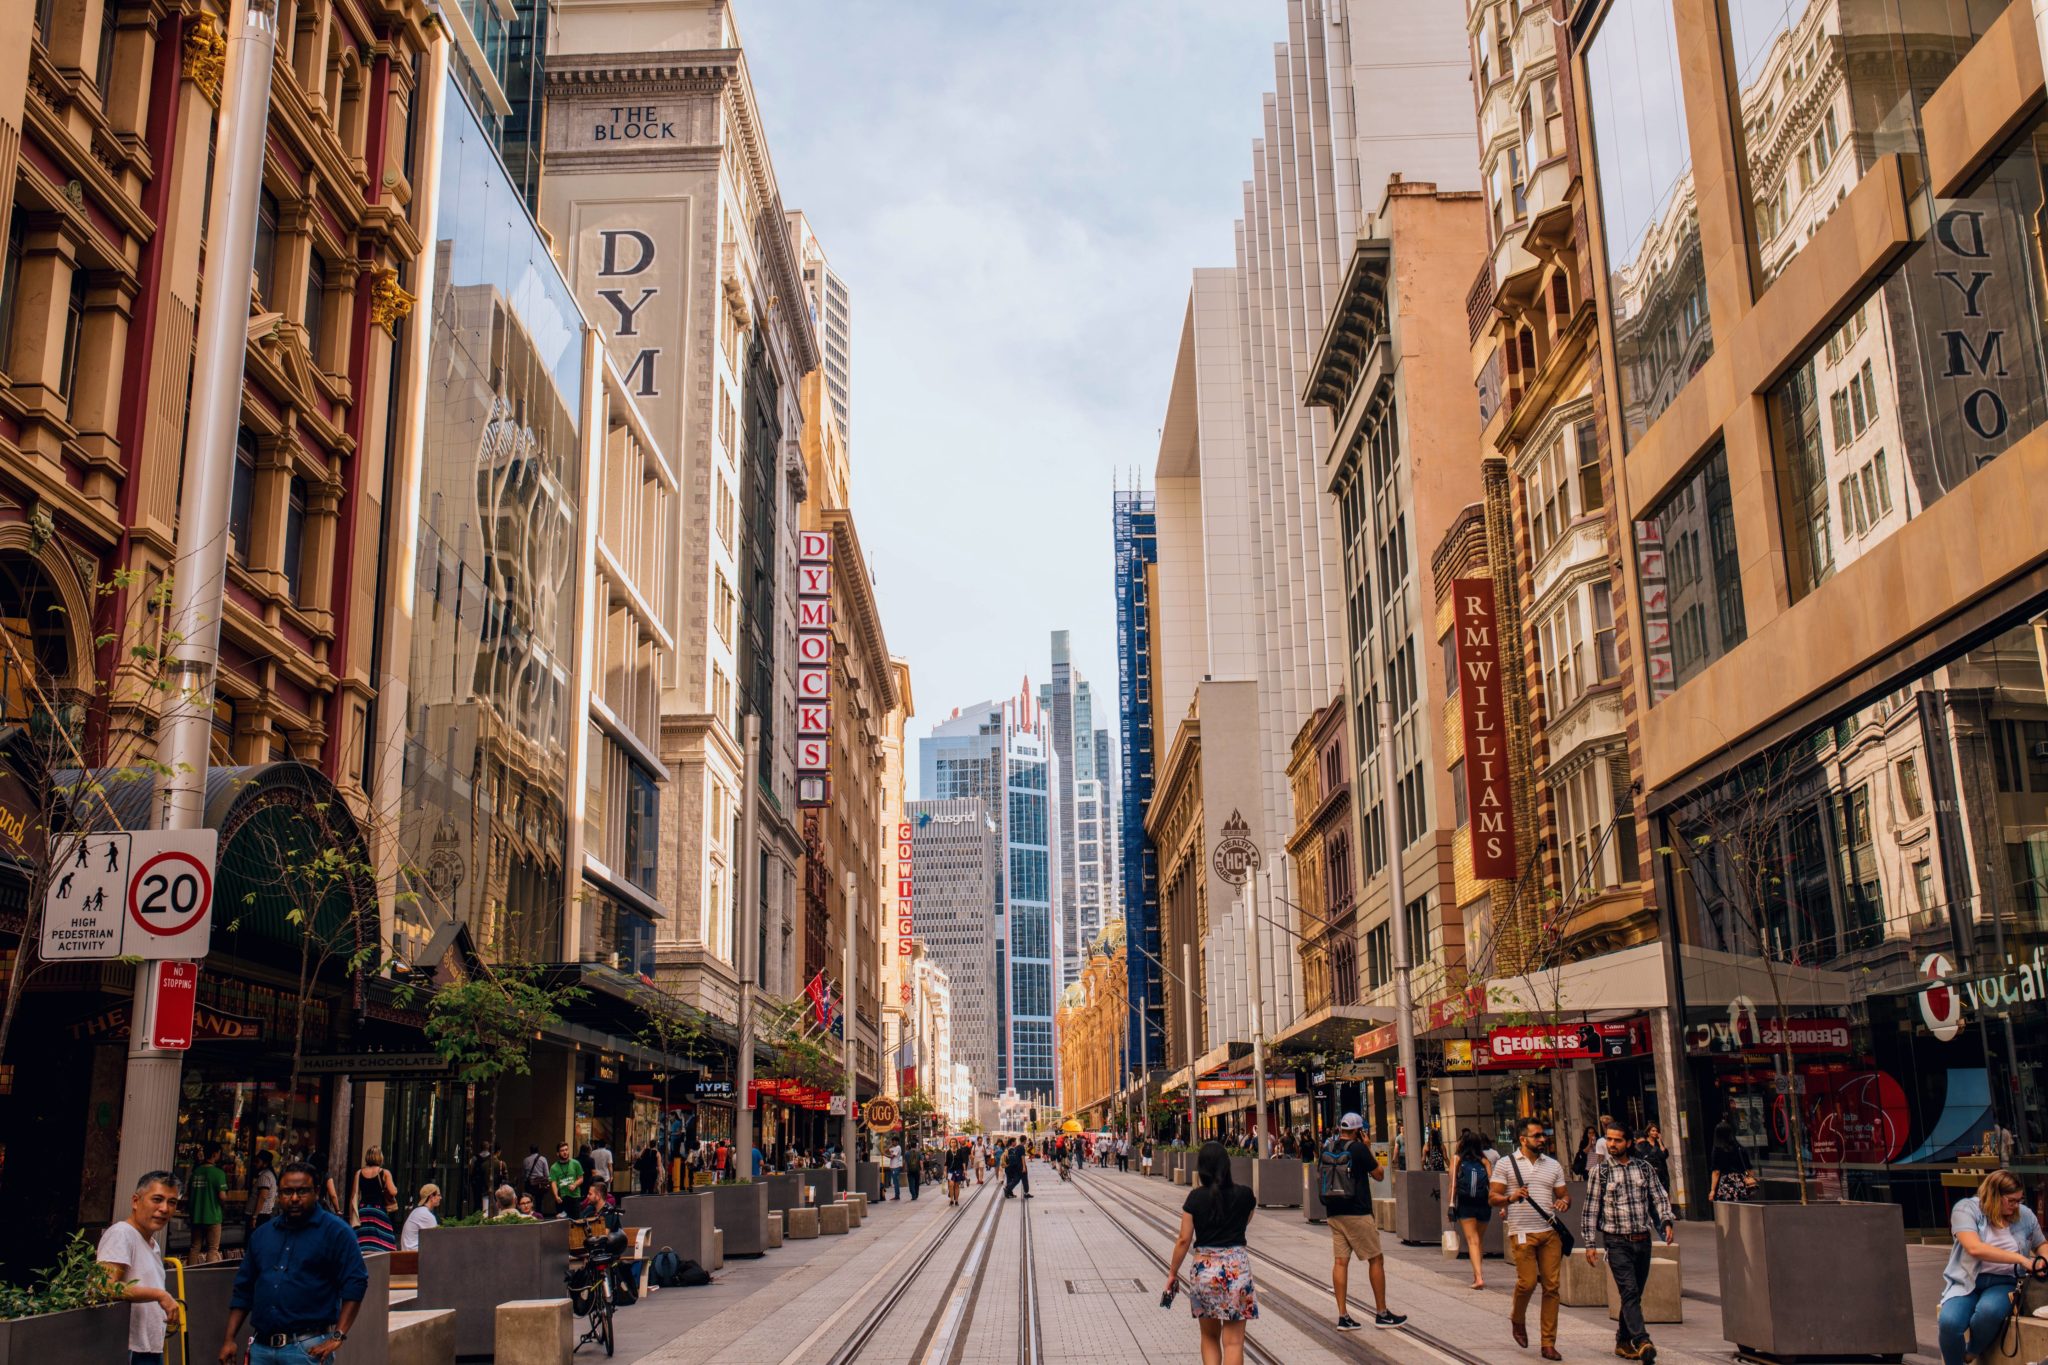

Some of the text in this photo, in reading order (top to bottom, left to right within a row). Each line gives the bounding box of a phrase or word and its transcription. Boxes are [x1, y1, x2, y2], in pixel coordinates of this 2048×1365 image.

[611, 106, 658, 122] THE
[595, 122, 676, 141] BLOCK
[800, 535, 826, 765] DYMOCKS
[932, 811, 976, 826] Ausgrid
[1221, 840, 1252, 851] HEALTH
[1226, 852, 1248, 870] HCF
[1215, 861, 1232, 880] CARE
[141, 873, 198, 914] 20
[900, 824, 912, 954] GOWINGS
[71, 918, 96, 928] HIGH
[52, 929, 114, 939] PEDESTRIAN
[58, 940, 105, 951] ACTIVITY
[173, 967, 184, 976] NO
[1965, 945, 2048, 1010] vodaf
[163, 978, 192, 990] STOPPING
[304, 1057, 443, 1069] HAIGH'S CHOCOLATES
[695, 1082, 730, 1092] HYPE
[872, 1105, 891, 1121] UGG
